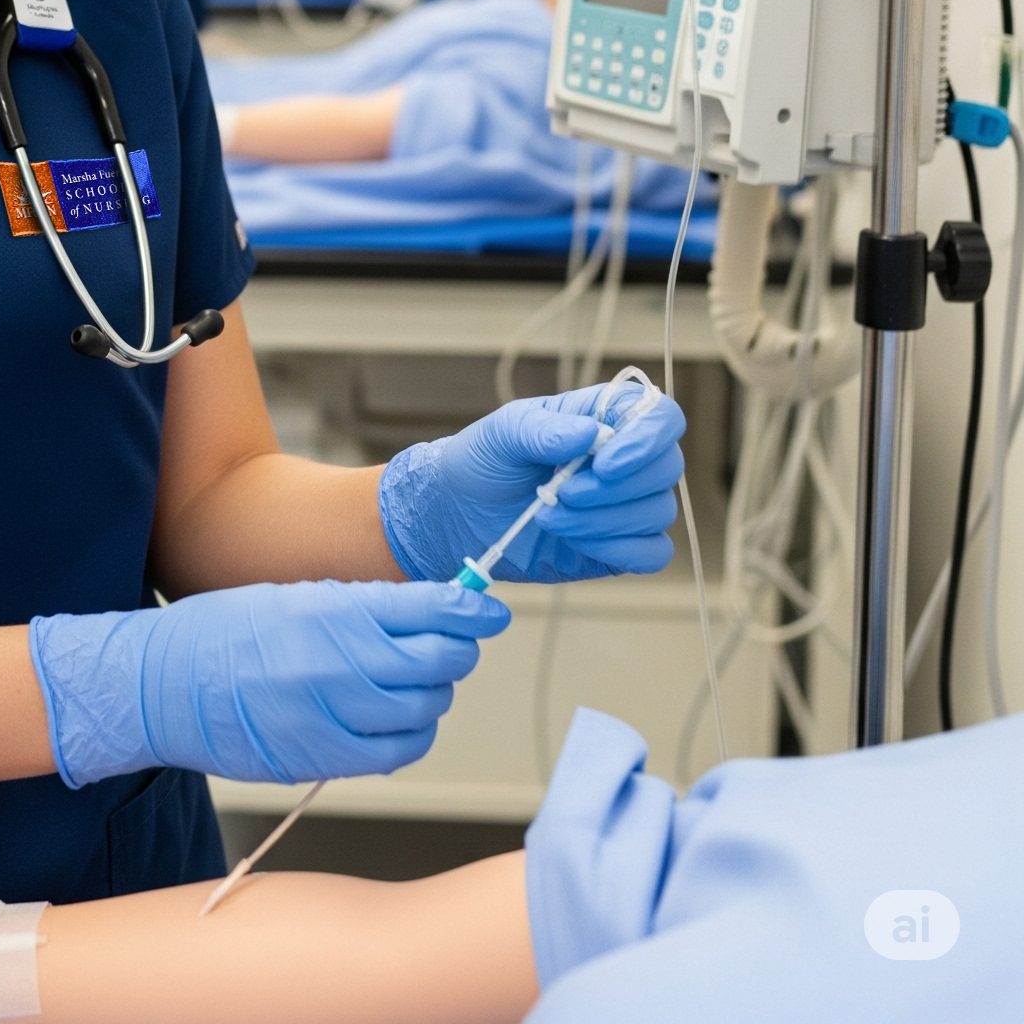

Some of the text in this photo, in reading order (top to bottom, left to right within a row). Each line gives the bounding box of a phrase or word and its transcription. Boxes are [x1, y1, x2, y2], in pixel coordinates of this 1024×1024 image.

[61, 169, 119, 185] Marsha Fuer
[70, 194, 151, 219] of NURSIG
